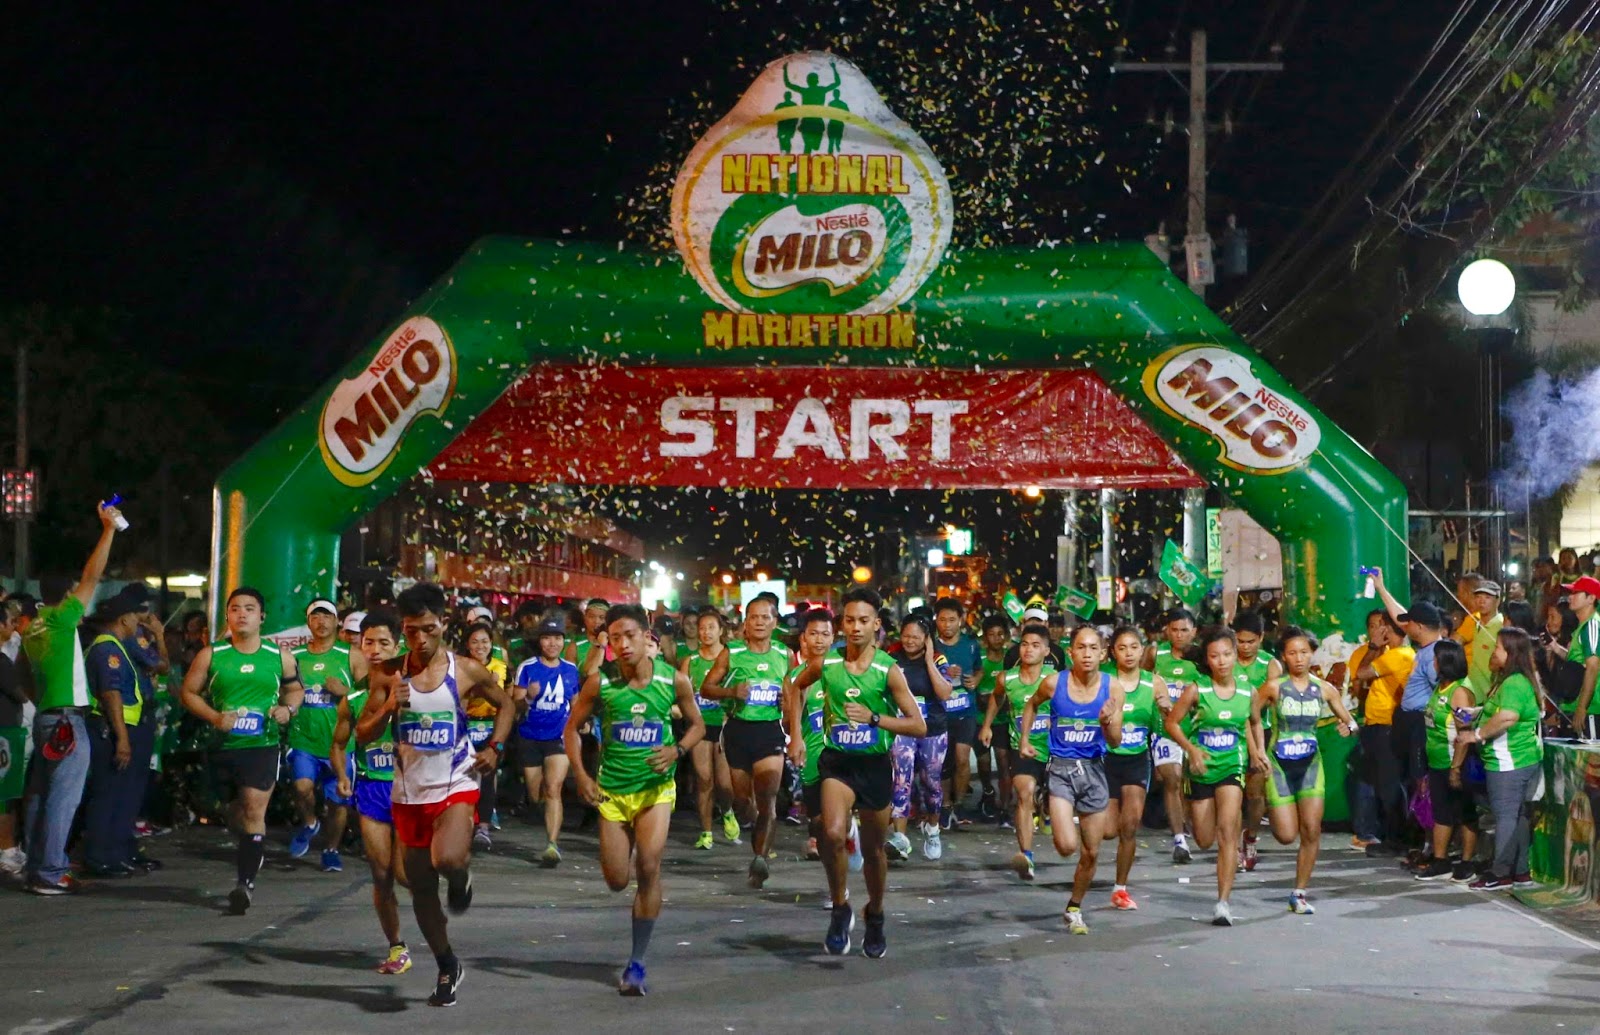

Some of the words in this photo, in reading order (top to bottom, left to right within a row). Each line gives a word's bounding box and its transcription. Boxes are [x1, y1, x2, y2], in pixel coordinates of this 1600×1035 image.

[721, 153, 910, 194] NATIONAL
[753, 229, 873, 275] MILO
[702, 311, 916, 347] MARATHON
[333, 339, 441, 463] MILO
[1166, 357, 1298, 460] MILO
[659, 396, 969, 461] START
[750, 690, 778, 702] 10083
[407, 728, 449, 744] 10043
[619, 727, 658, 743] 10031
[838, 730, 871, 744] 10124
[1064, 730, 1095, 743] 10077
[1157, 745, 1170, 759] 18
